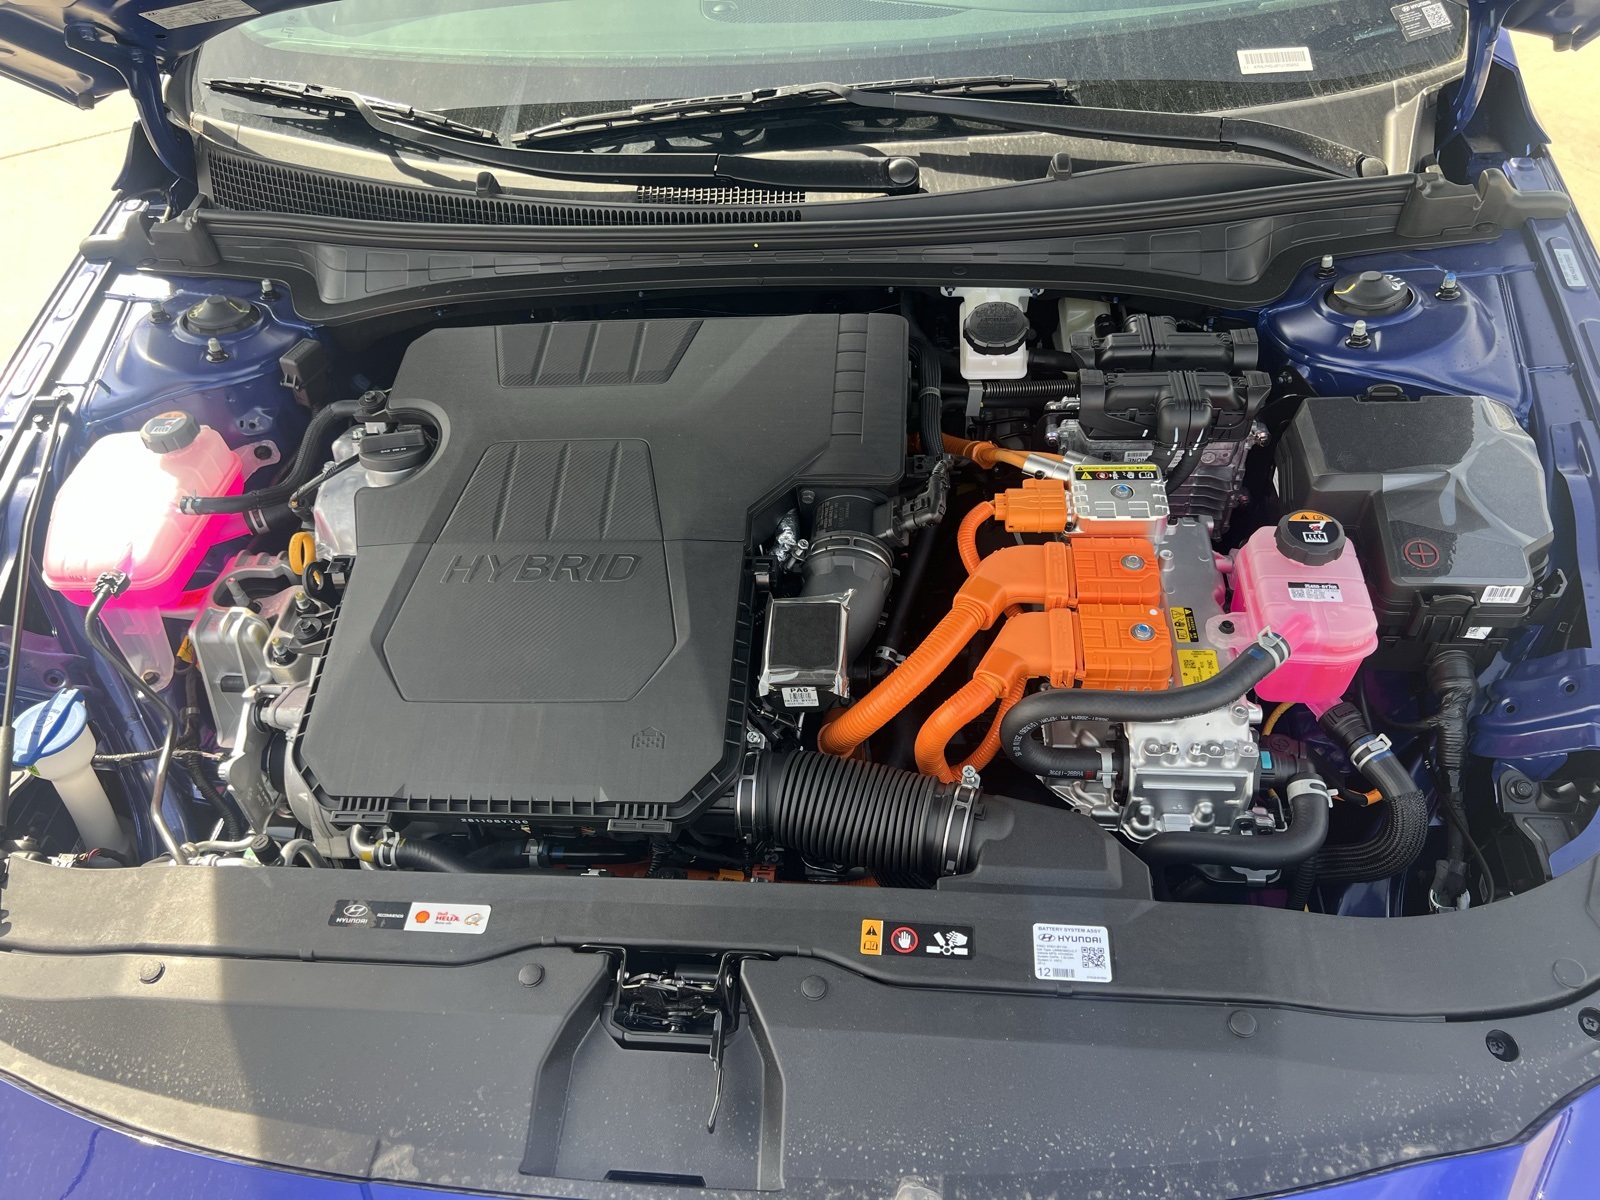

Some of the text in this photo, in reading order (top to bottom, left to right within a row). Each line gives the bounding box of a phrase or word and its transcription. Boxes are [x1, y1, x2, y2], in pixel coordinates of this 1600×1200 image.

[439, 553, 641, 583] HYBRID
[1058, 935, 1102, 943] HYUNDAI
[1037, 967, 1051, 977] 12
